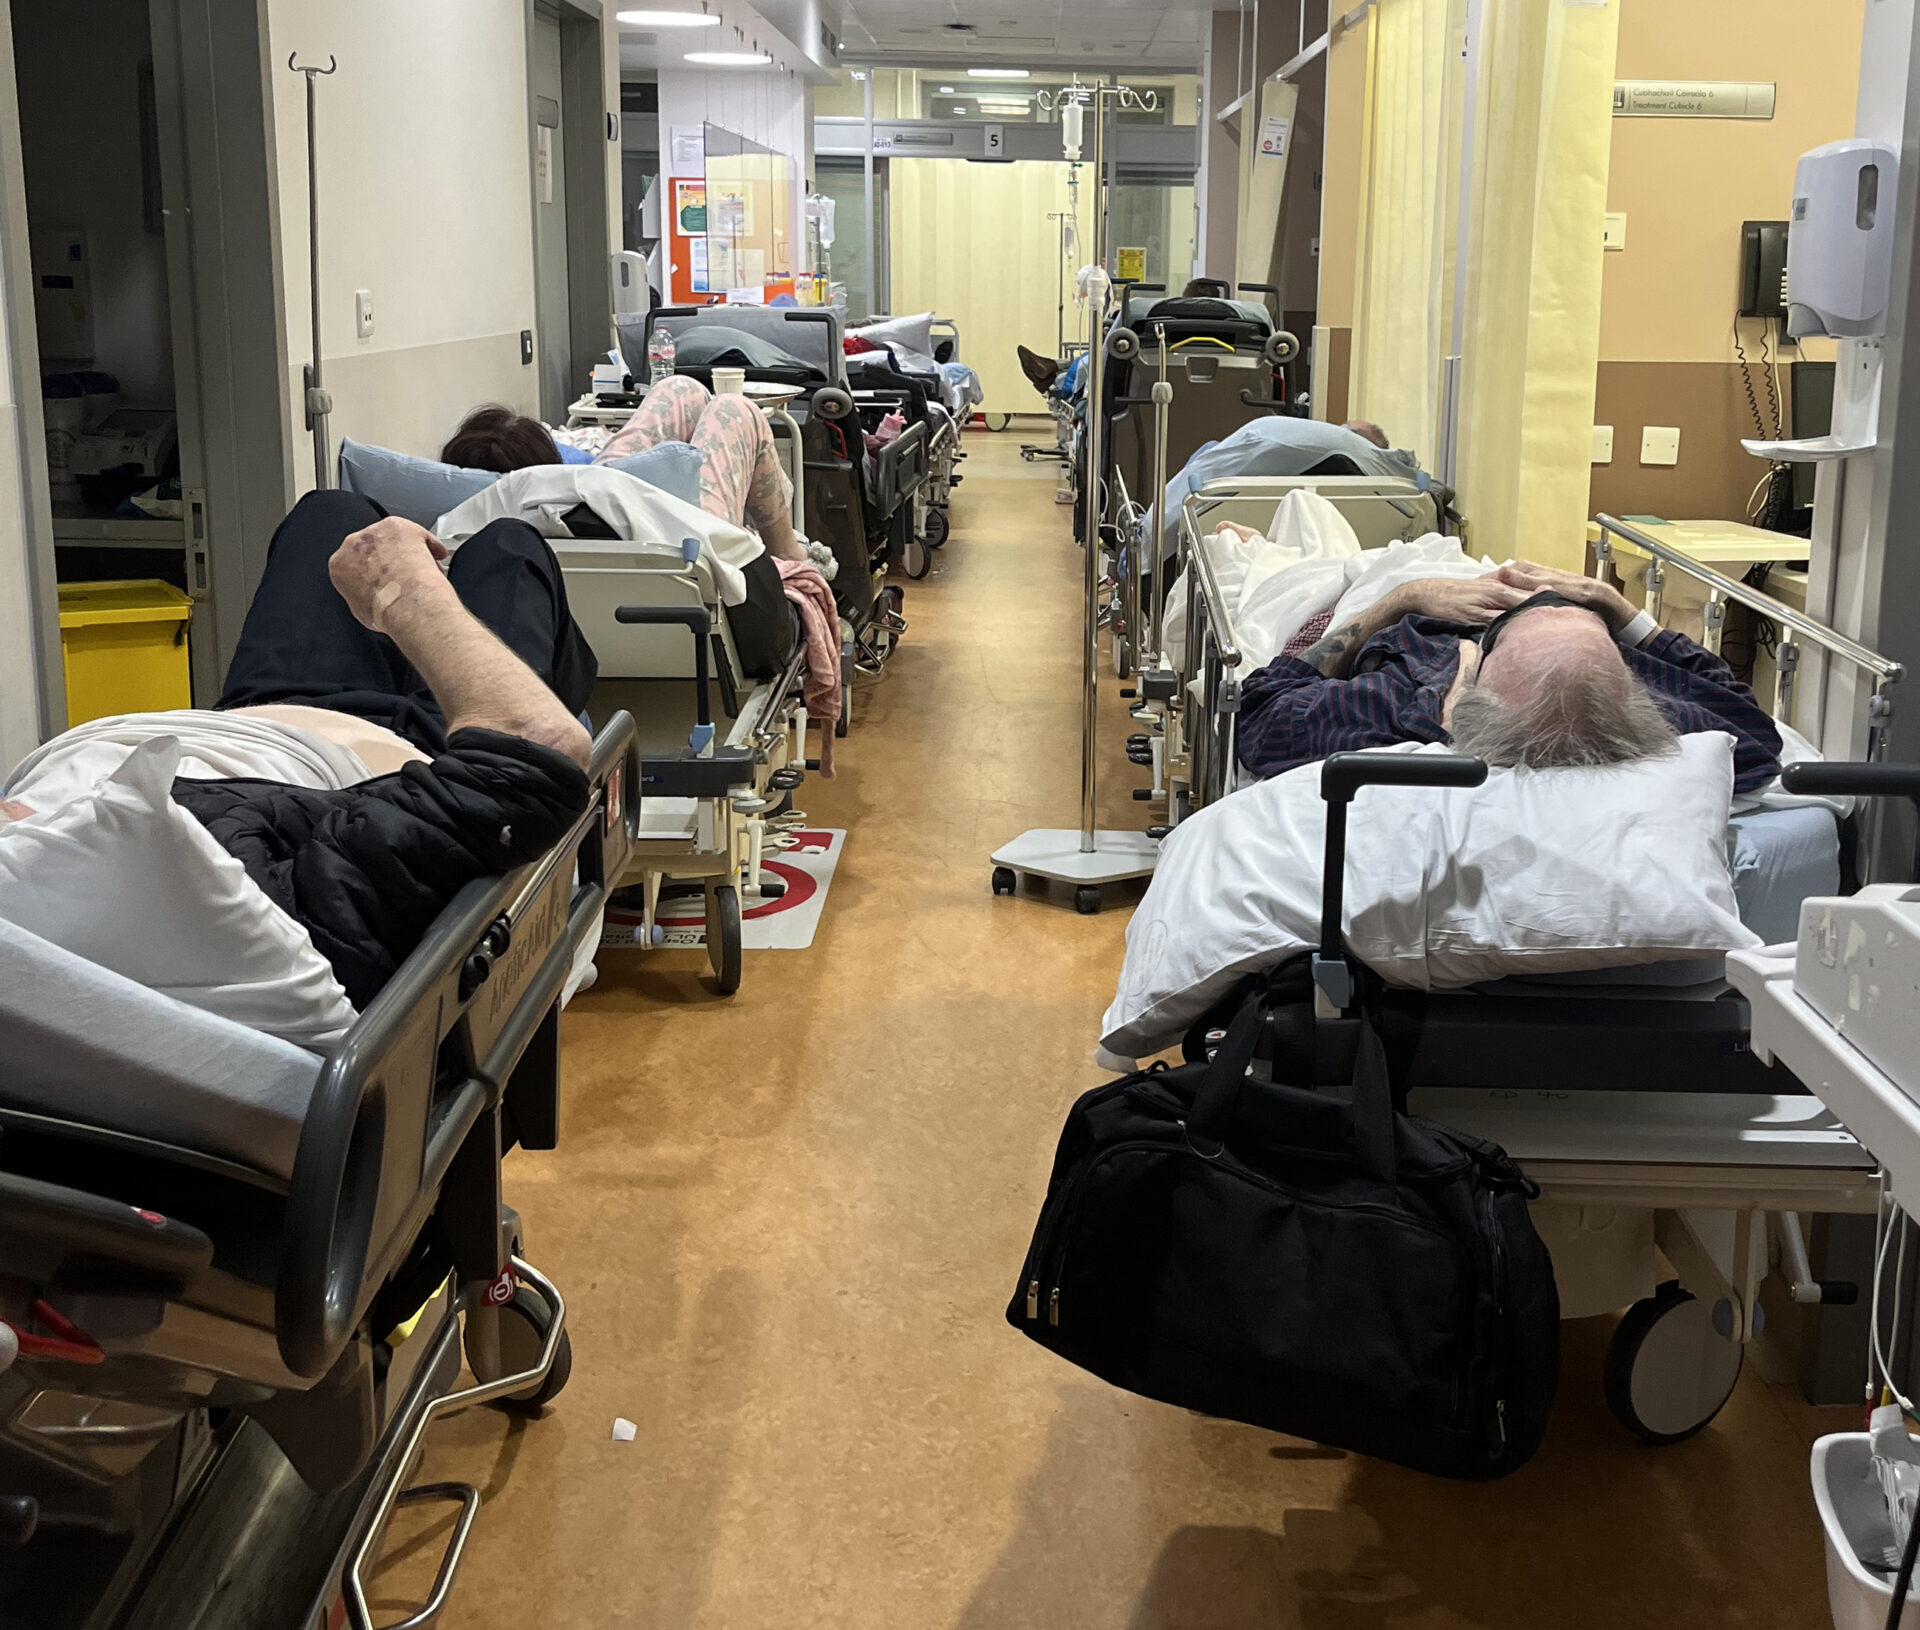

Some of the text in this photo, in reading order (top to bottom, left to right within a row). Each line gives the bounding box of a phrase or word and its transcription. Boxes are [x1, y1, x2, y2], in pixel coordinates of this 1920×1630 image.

[1632, 100, 1702, 110] Treatment Cubicle 6
[990, 134, 998, 147] 5
